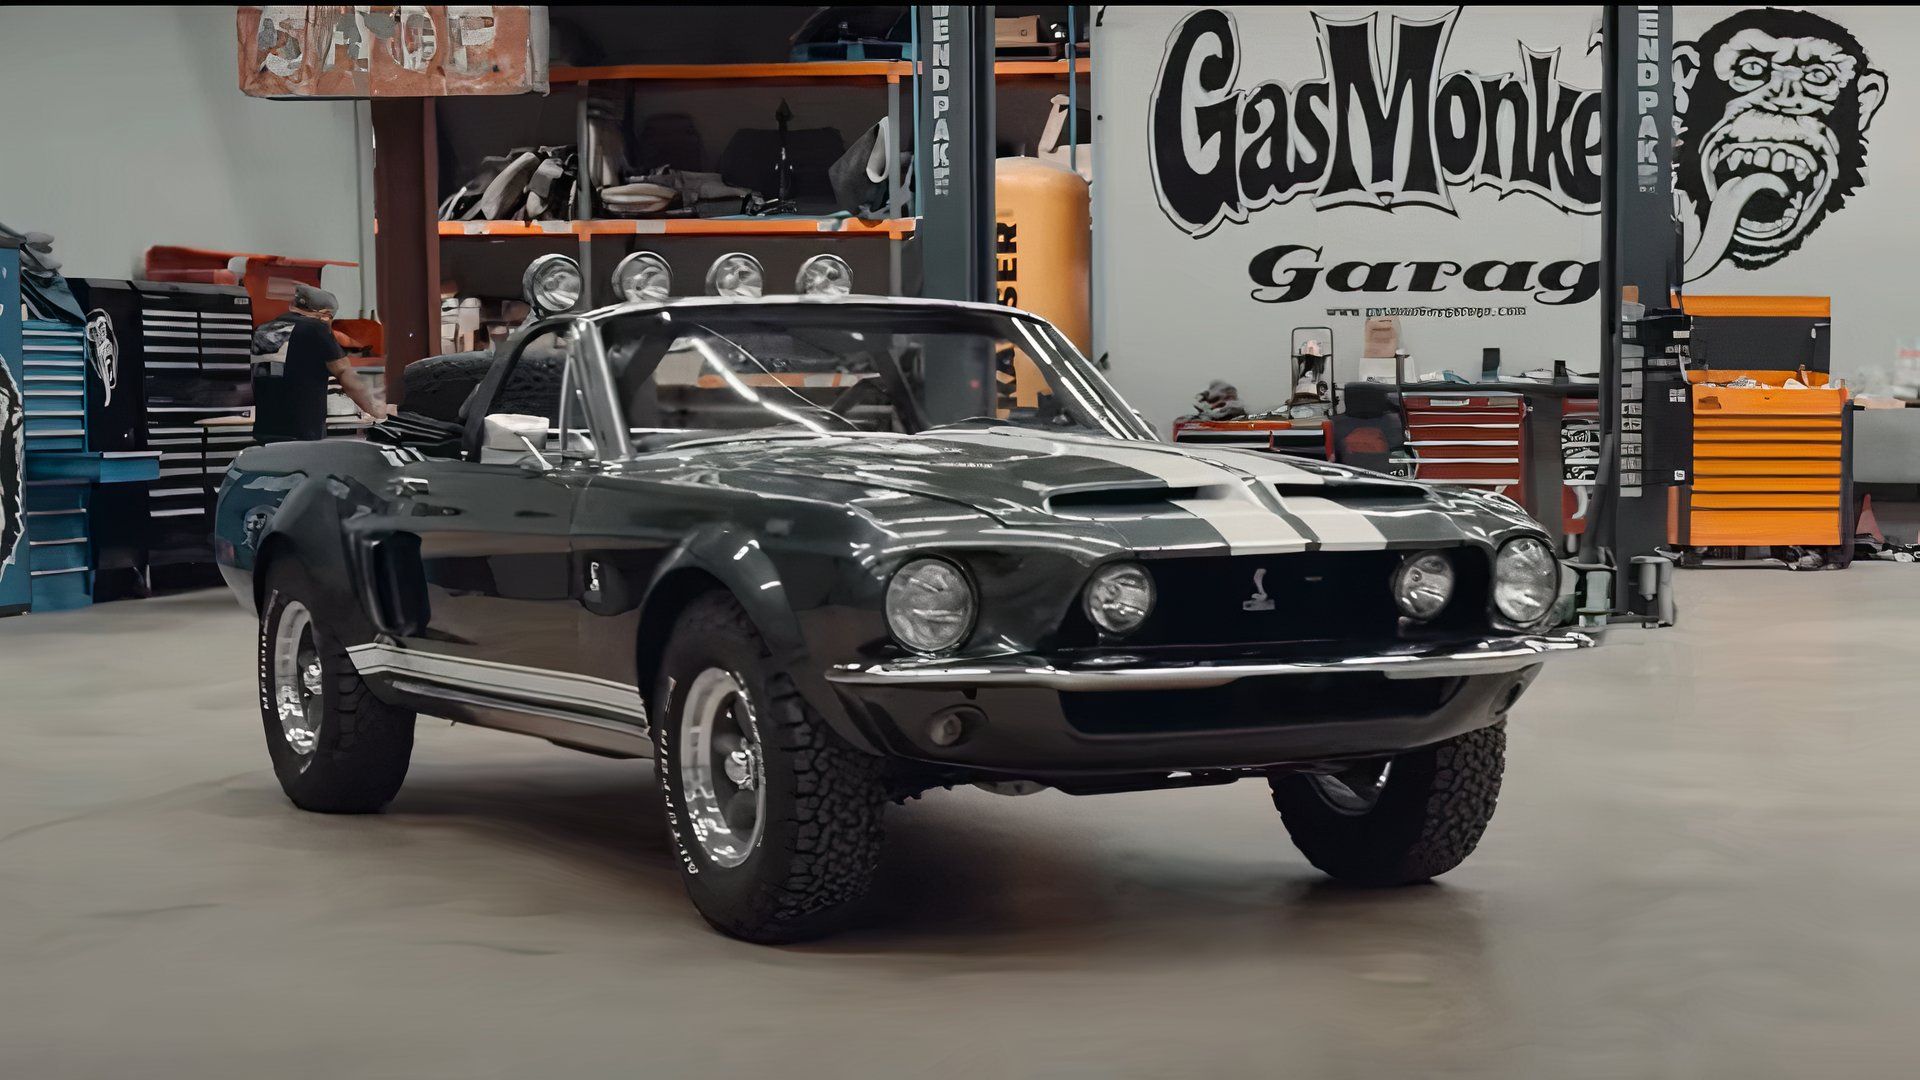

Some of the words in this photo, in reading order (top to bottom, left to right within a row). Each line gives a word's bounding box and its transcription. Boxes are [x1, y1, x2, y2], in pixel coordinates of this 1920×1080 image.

[1638, 6, 1659, 165] ENDPAK
[995, 222, 1018, 410] KASER
[1248, 244, 1602, 304] Garag
